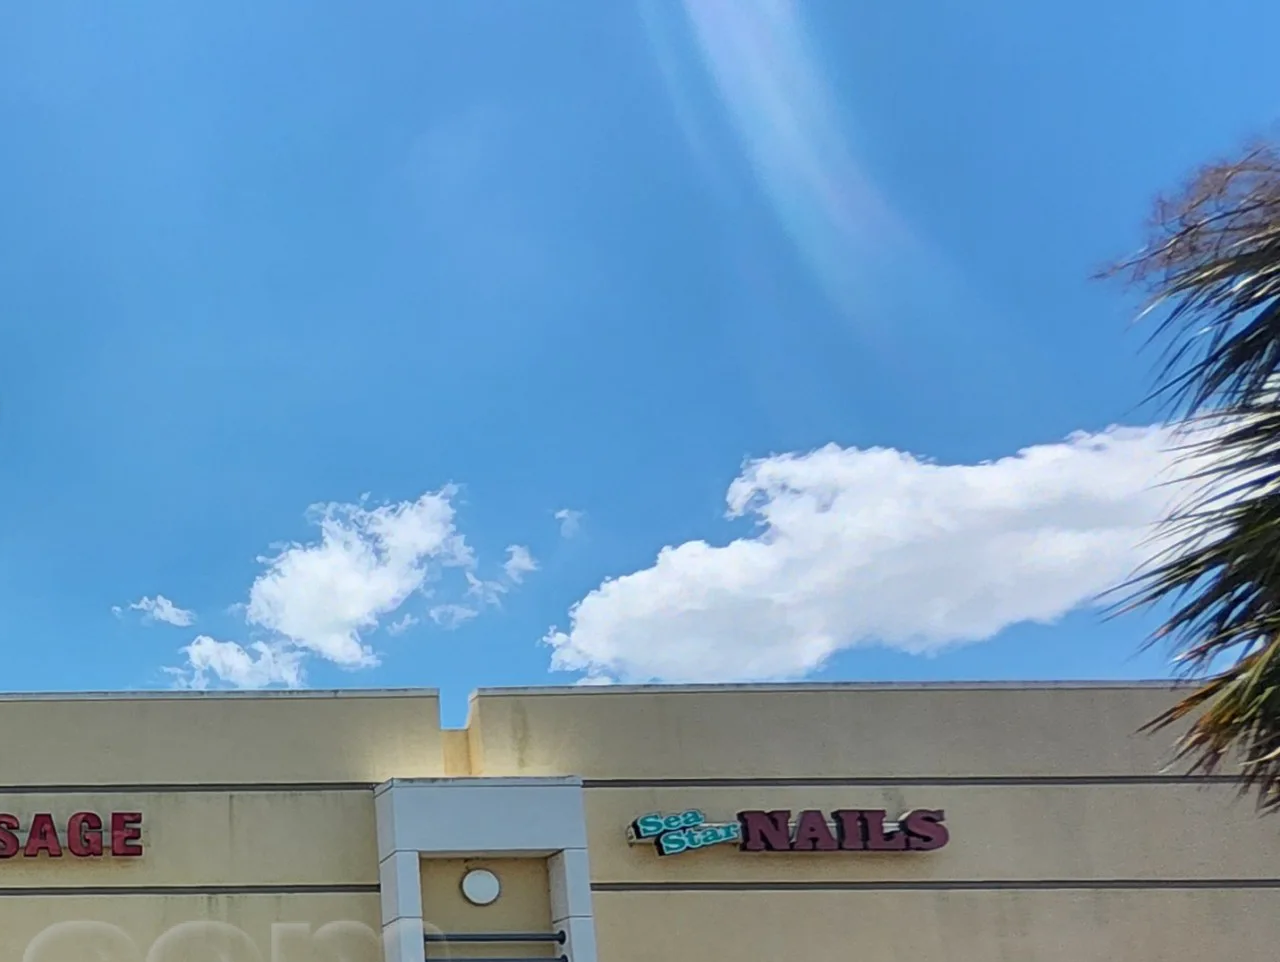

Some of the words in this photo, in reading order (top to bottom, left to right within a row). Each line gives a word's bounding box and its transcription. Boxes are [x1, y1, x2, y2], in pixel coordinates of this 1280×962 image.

[637, 808, 705, 838] Sea
[659, 822, 741, 855] Star
[739, 808, 949, 852] NAILS
